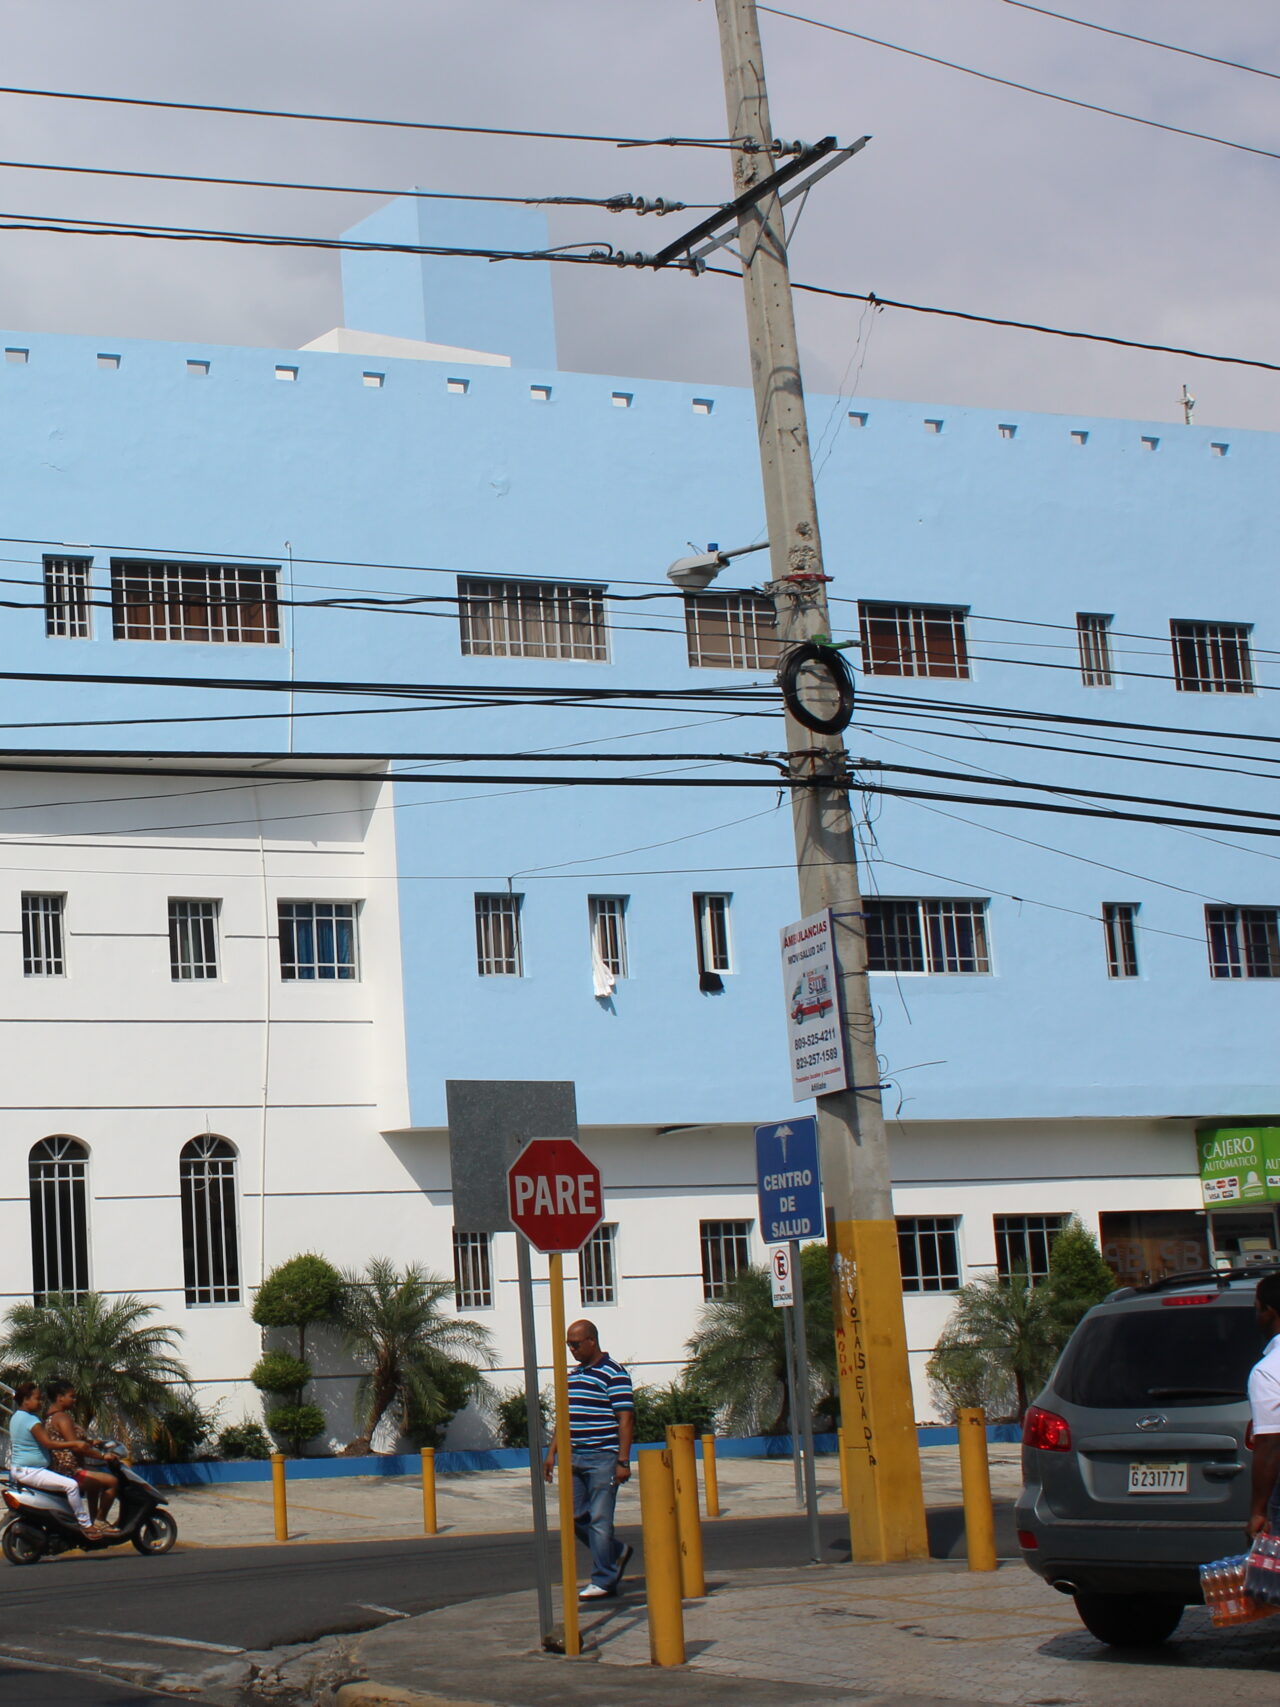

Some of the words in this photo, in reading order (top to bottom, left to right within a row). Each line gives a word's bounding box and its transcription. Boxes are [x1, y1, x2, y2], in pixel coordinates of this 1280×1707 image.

[796, 1047, 838, 1070] 829-257-1589
[1202, 1136, 1255, 1160] CAJERO
[763, 1169, 812, 1191] CENTRO
[515, 1174, 596, 1215] PARE
[779, 1195, 797, 1213] DE
[771, 1217, 811, 1238] SALUD
